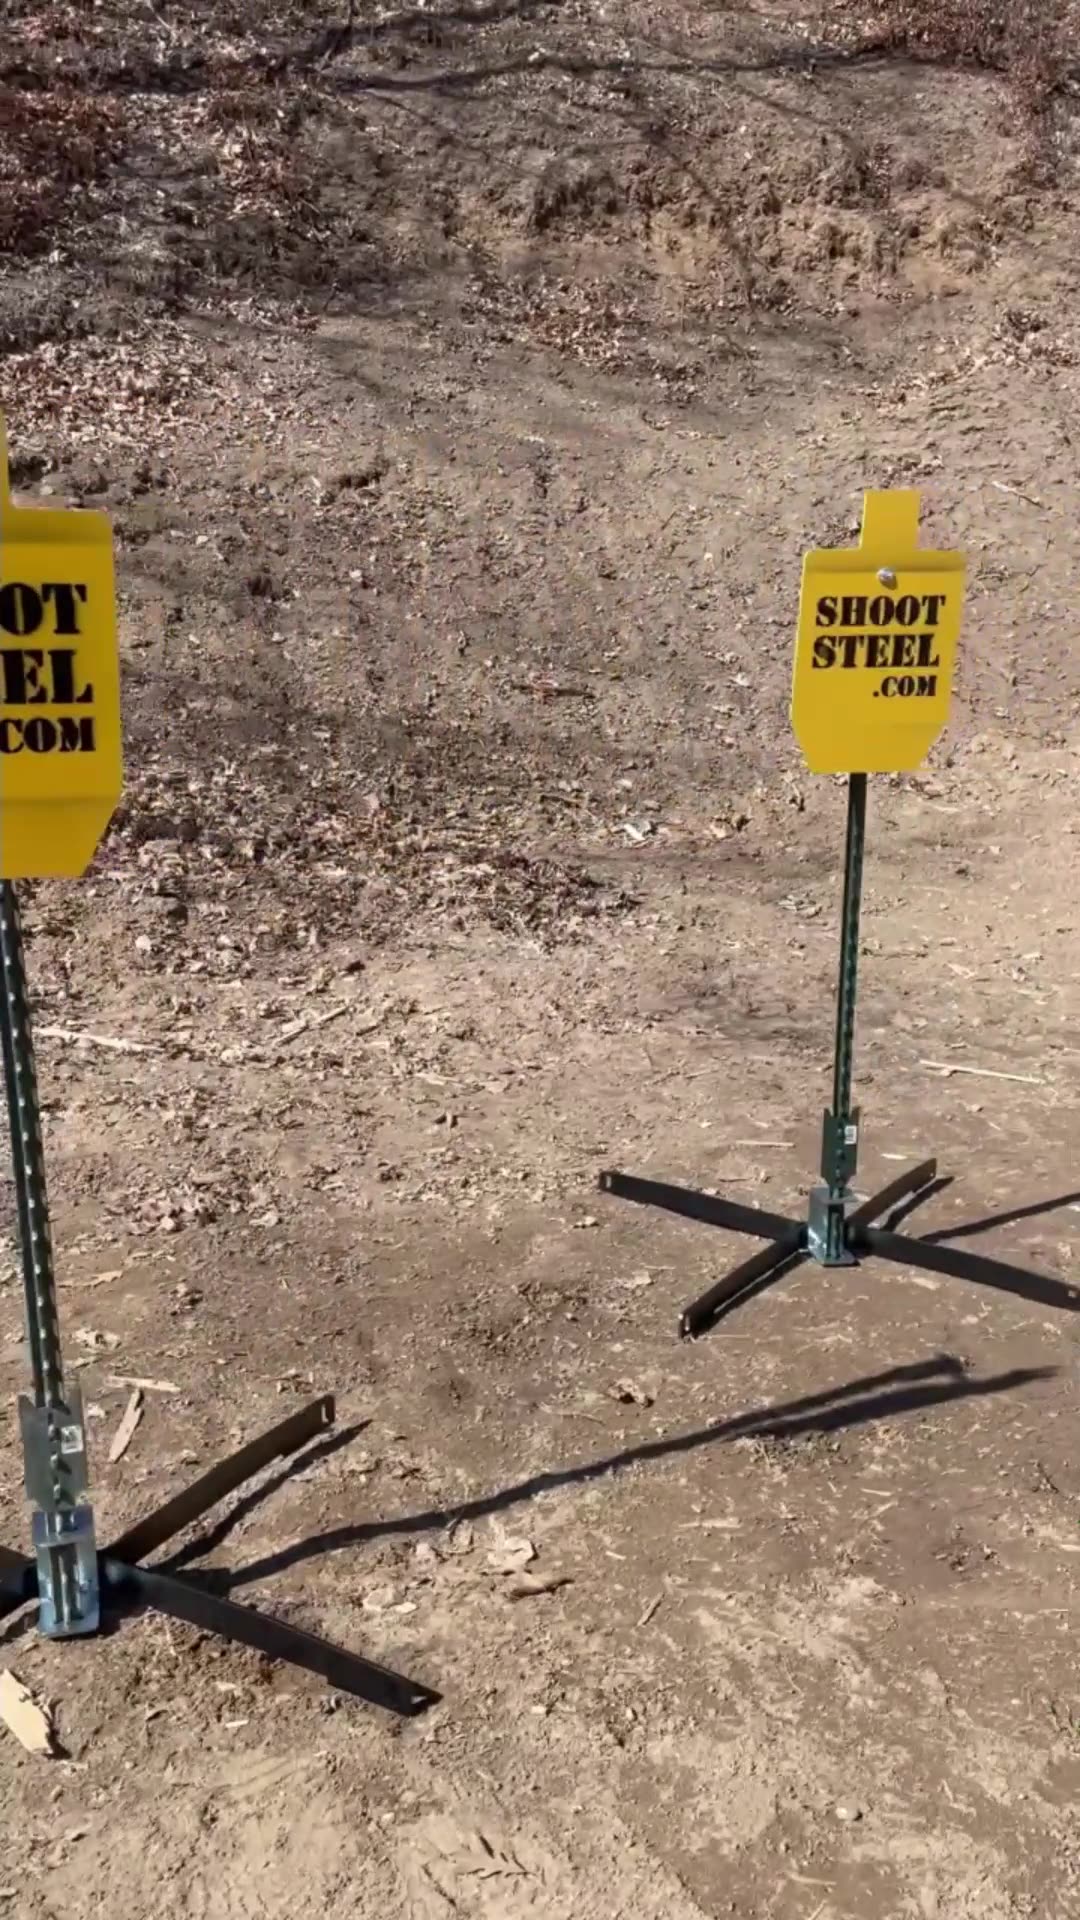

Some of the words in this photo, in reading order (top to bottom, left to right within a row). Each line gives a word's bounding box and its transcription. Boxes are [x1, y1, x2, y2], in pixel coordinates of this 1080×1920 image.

[0, 583, 87, 635] OT
[815, 595, 946, 627] SHOOT
[812, 633, 940, 669] STEEL
[1, 649, 94, 704] EL
[872, 675, 938, 698] .COM
[0, 717, 96, 754] COM
